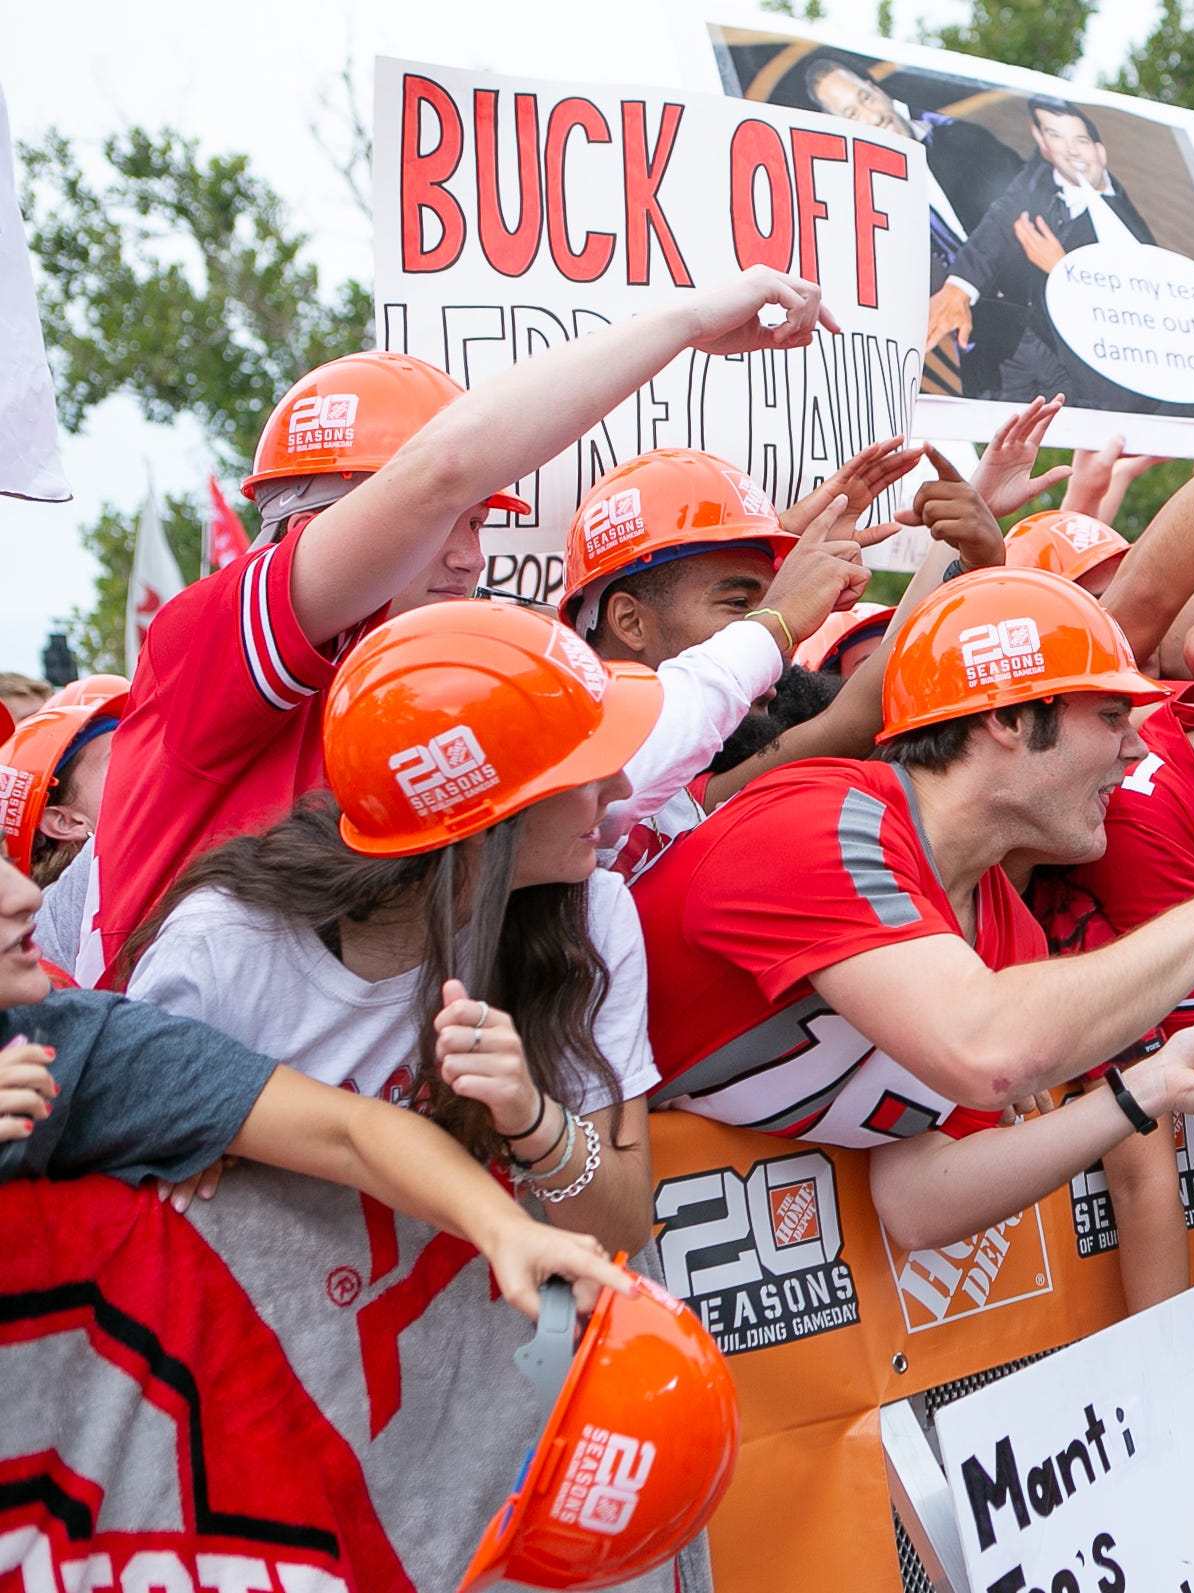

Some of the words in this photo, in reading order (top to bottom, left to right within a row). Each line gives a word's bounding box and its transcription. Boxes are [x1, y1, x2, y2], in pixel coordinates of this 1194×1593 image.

[401, 74, 696, 288] BUCK
[730, 119, 909, 309] OFF
[1065, 263, 1122, 293] Keep
[1129, 277, 1161, 299] my
[1092, 304, 1156, 331] name
[1092, 338, 1158, 366] damn
[289, 393, 359, 433] 20
[288, 428, 354, 446] SEASONS
[583, 487, 641, 542] 20
[587, 517, 644, 552] SEASONS
[959, 617, 1041, 667] 20
[966, 653, 1045, 680] SEASONS
[388, 725, 486, 797] 20
[410, 764, 497, 811] SEASONS
[656, 1152, 841, 1300] 20
[775, 1183, 815, 1244] HOME
[776, 1192, 794, 1217] THE
[793, 1202, 817, 1240] DEPOT
[1079, 1237, 1093, 1255] OF
[699, 1264, 855, 1334] EASONS
[792, 1301, 859, 1338] GAMEDAY
[559, 1427, 610, 1525] SEASONS
[579, 1433, 656, 1536] 20
[961, 1403, 1136, 1552] Manti
